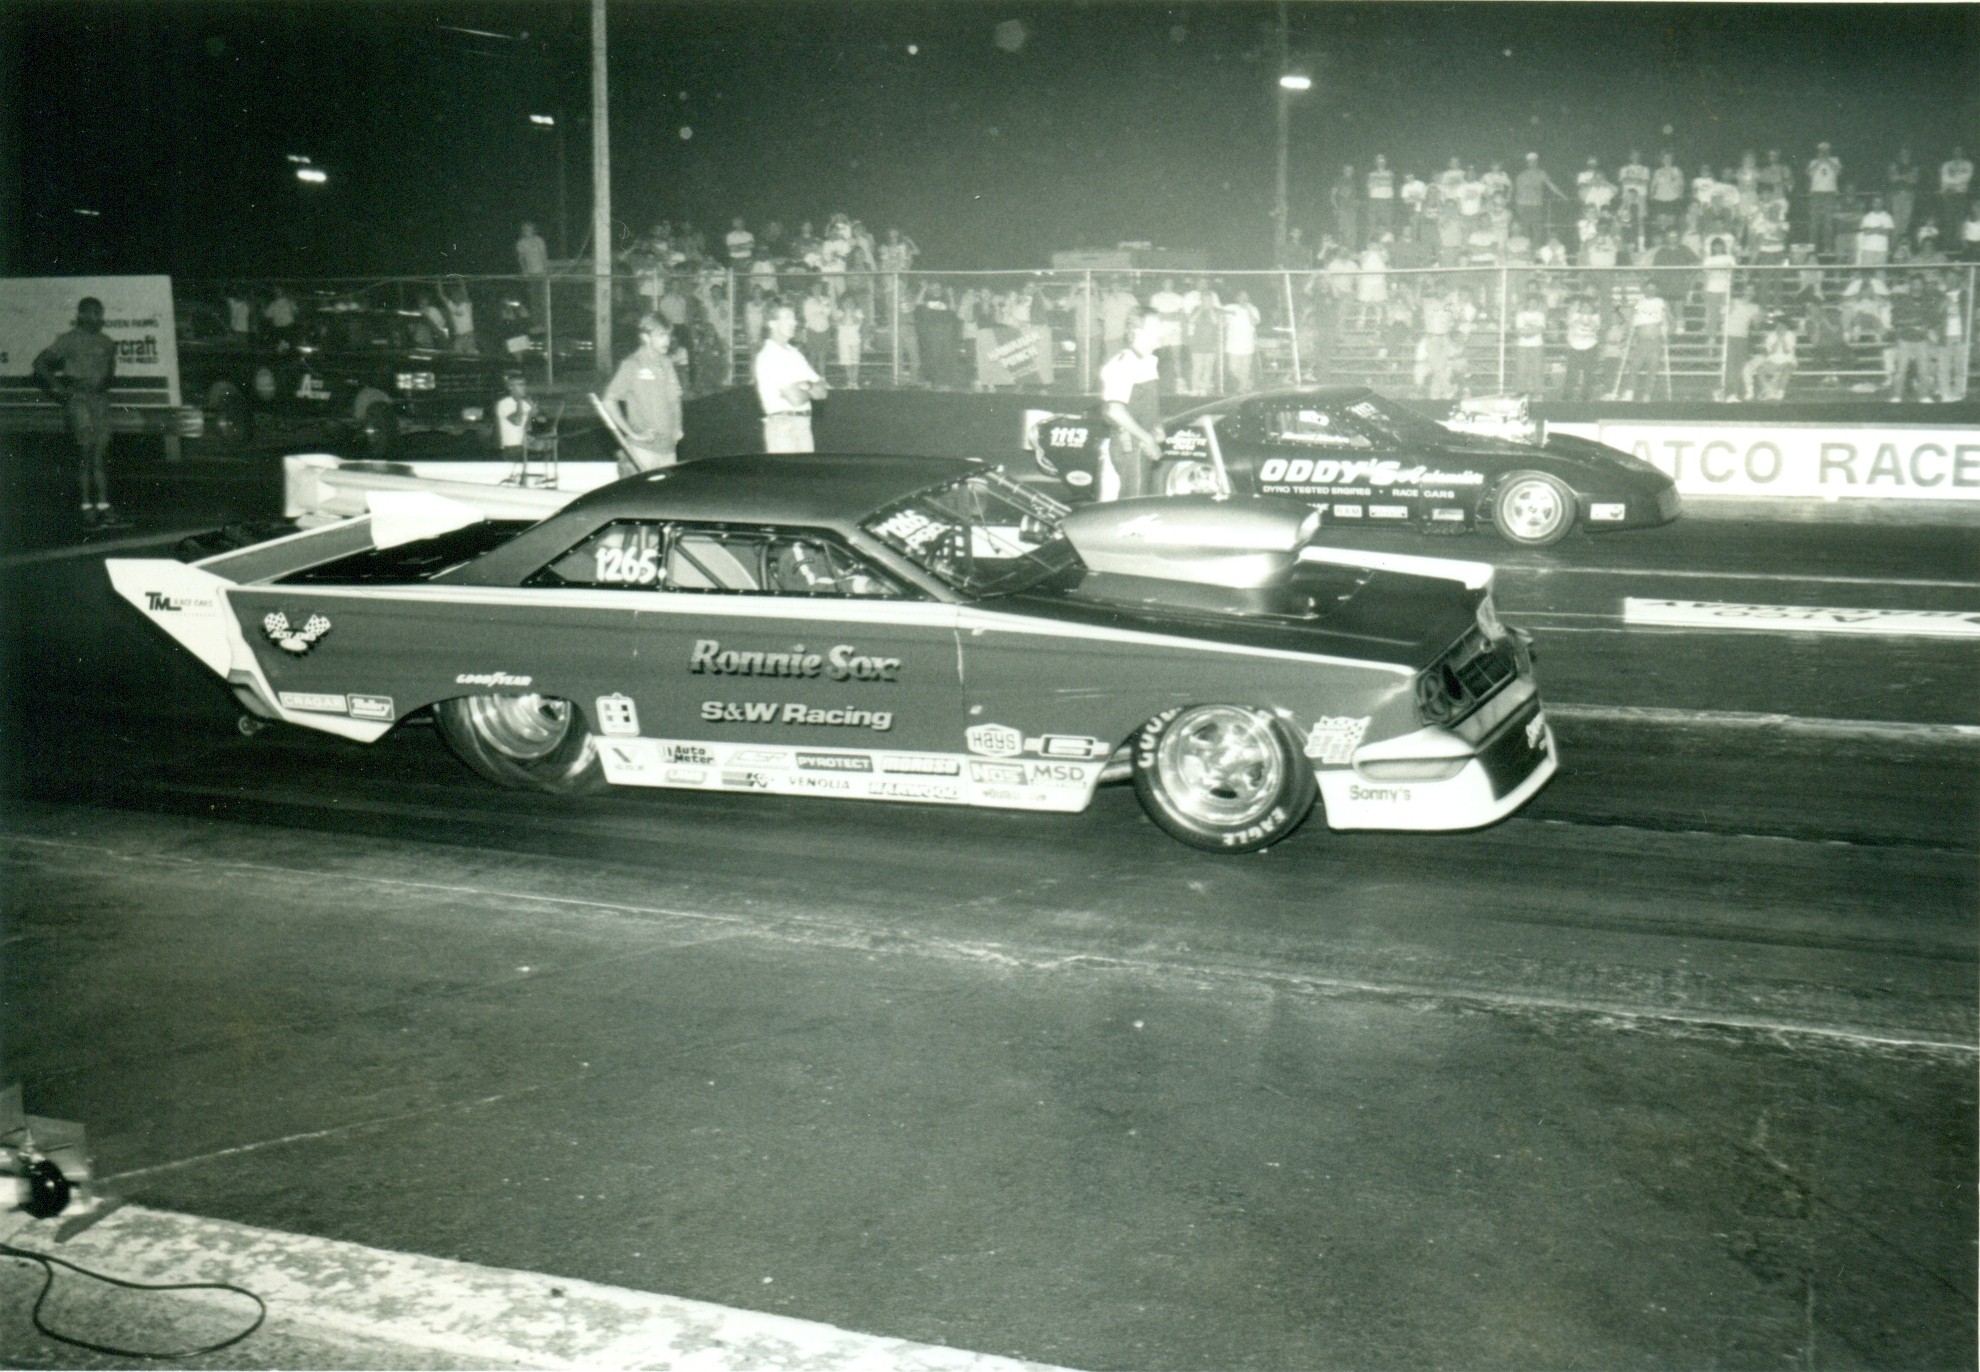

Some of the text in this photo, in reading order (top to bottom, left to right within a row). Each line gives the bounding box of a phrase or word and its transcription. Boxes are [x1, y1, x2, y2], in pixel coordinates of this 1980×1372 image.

[1259, 458, 1401, 486] ODDY'S
[1818, 442, 1980, 488] RACE
[1263, 485, 1290, 494] DYNO
[1292, 486, 1330, 495] TESTED
[1392, 488, 1419, 498] RACE
[1423, 489, 1455, 499] CARS
[595, 546, 658, 585] 1265
[690, 638, 902, 682] Ronnie Sox
[701, 701, 894, 731] S&W Racing
[673, 754, 714, 764] Meter
[674, 745, 706, 756] Auto
[798, 756, 871, 769] PYROTECT
[788, 775, 850, 789] VENOLIA
[1032, 764, 1085, 781] MSD
[1349, 784, 1412, 803] Sonny's
[1222, 806, 1287, 846] EAGLE
